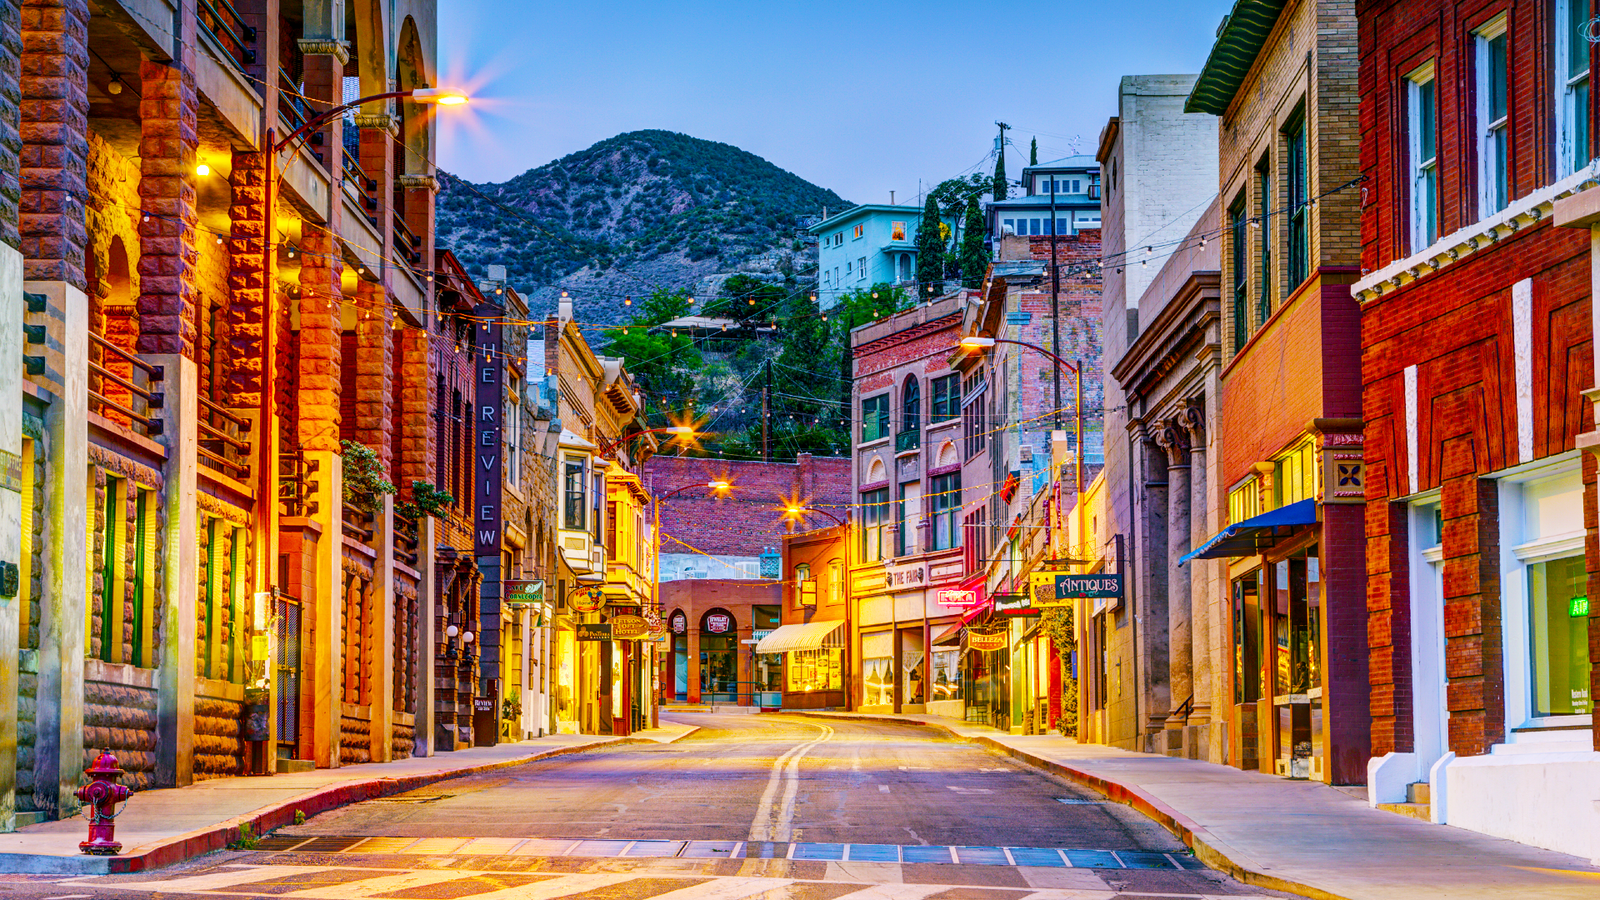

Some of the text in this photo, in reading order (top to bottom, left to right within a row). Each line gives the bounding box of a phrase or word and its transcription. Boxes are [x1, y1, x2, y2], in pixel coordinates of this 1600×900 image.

[480, 318, 496, 545] THE REVIEW
[893, 569, 918, 586] THE FAIR
[1060, 577, 1119, 596] ANTIQUES
